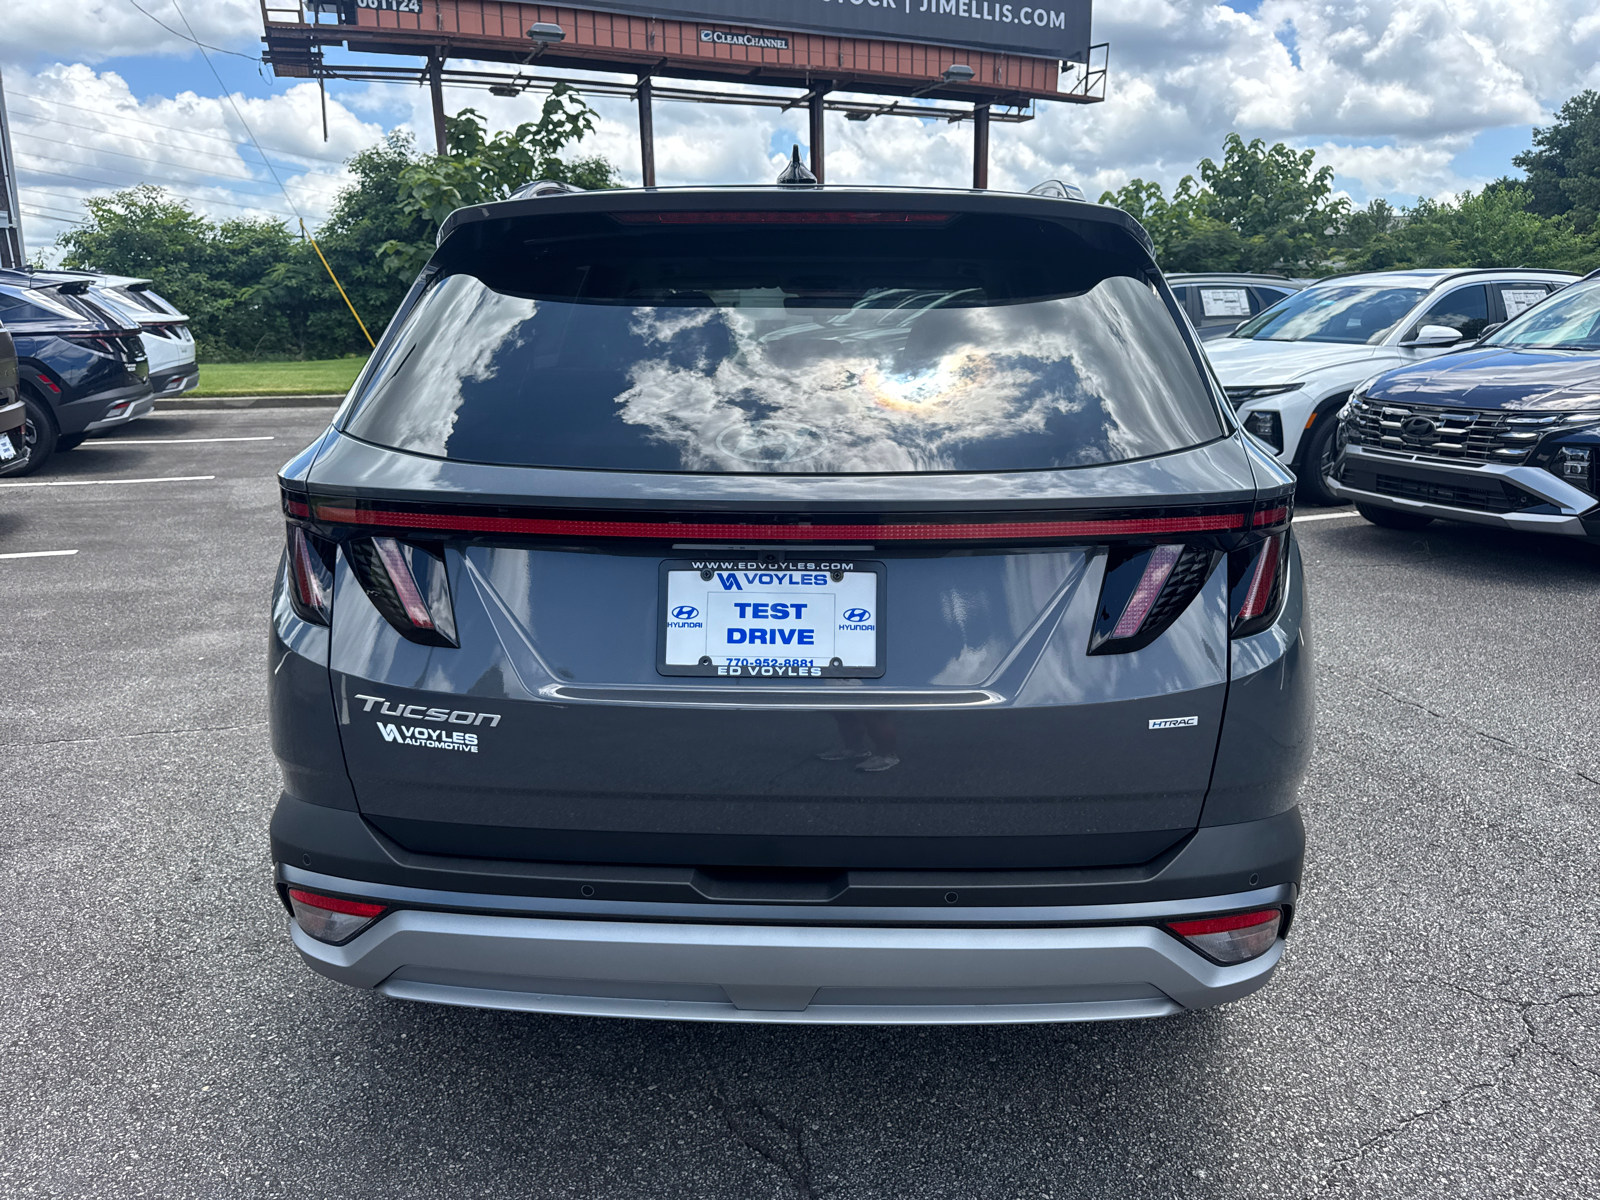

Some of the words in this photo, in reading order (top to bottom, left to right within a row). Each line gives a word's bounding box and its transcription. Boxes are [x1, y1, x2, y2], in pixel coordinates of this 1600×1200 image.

[919, 0, 1066, 30] JIMELLIS.COM
[691, 561, 854, 570] WWW.EDVOYLES.COM
[743, 573, 828, 586] VOYLES
[734, 602, 808, 620] TEST
[667, 621, 703, 629] HYUNDAI
[726, 628, 815, 645] DRIVE
[726, 658, 814, 667] 770-952-8881
[717, 666, 742, 676] ED
[748, 666, 822, 676] VOYLES
[1151, 717, 1195, 728] HTRAC
[401, 725, 478, 745] VOYLES
[404, 738, 479, 753] AUTOMOTIVE
